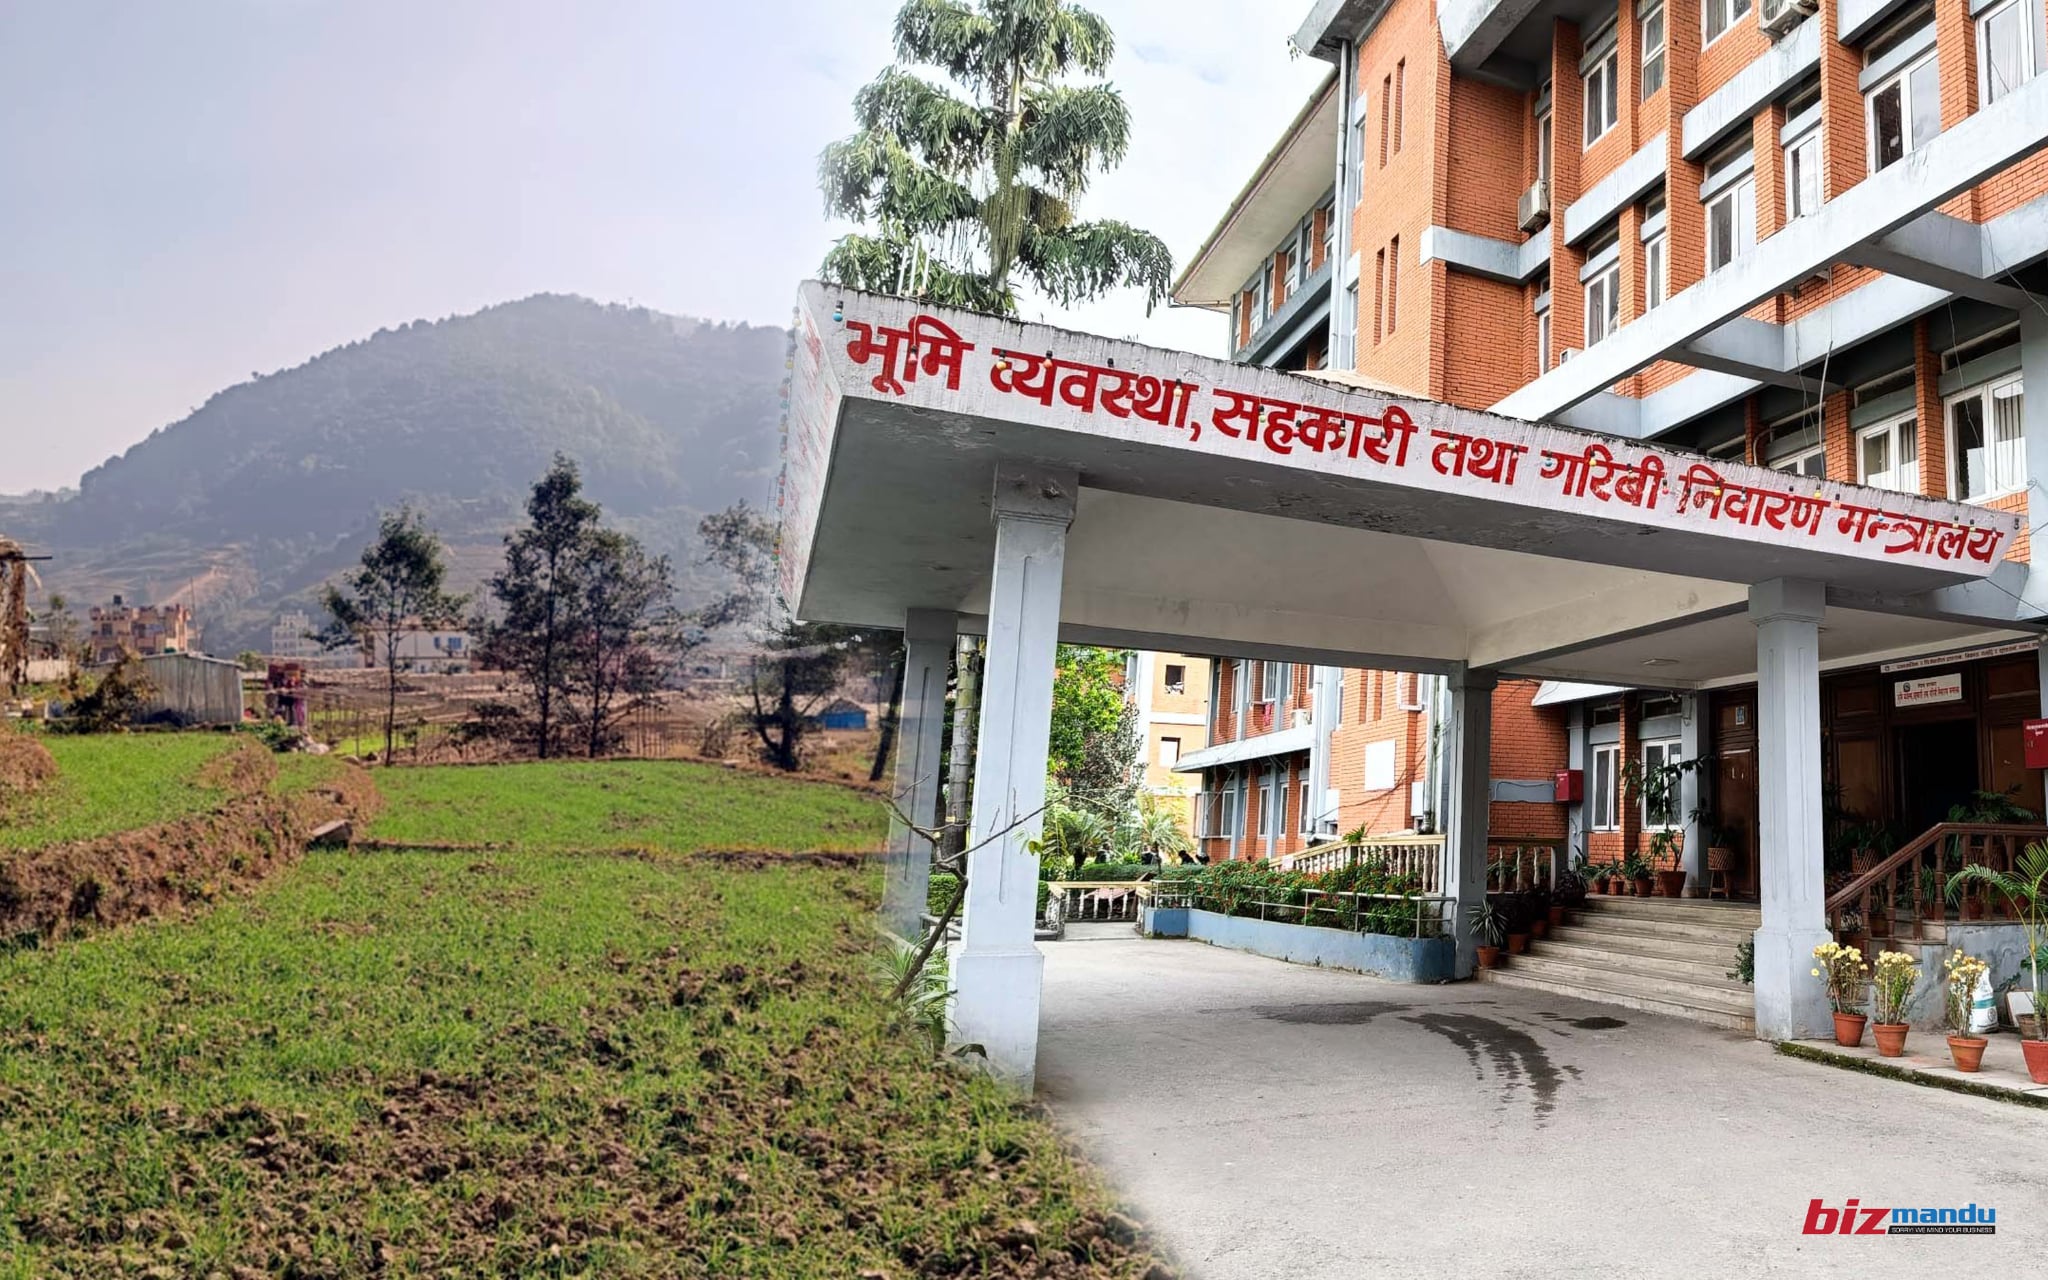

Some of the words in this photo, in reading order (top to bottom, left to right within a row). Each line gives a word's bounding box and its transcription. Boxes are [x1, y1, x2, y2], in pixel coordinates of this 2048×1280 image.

[846, 314, 975, 396] भूमि
[990, 347, 1202, 442] व्यवस्था,
[1211, 388, 1419, 467] सहकारी
[1430, 429, 1529, 486] तथा
[1540, 441, 1666, 510] गरिबी
[1677, 462, 1832, 536] निवारण
[1837, 503, 2005, 564] मन्त्रालय
